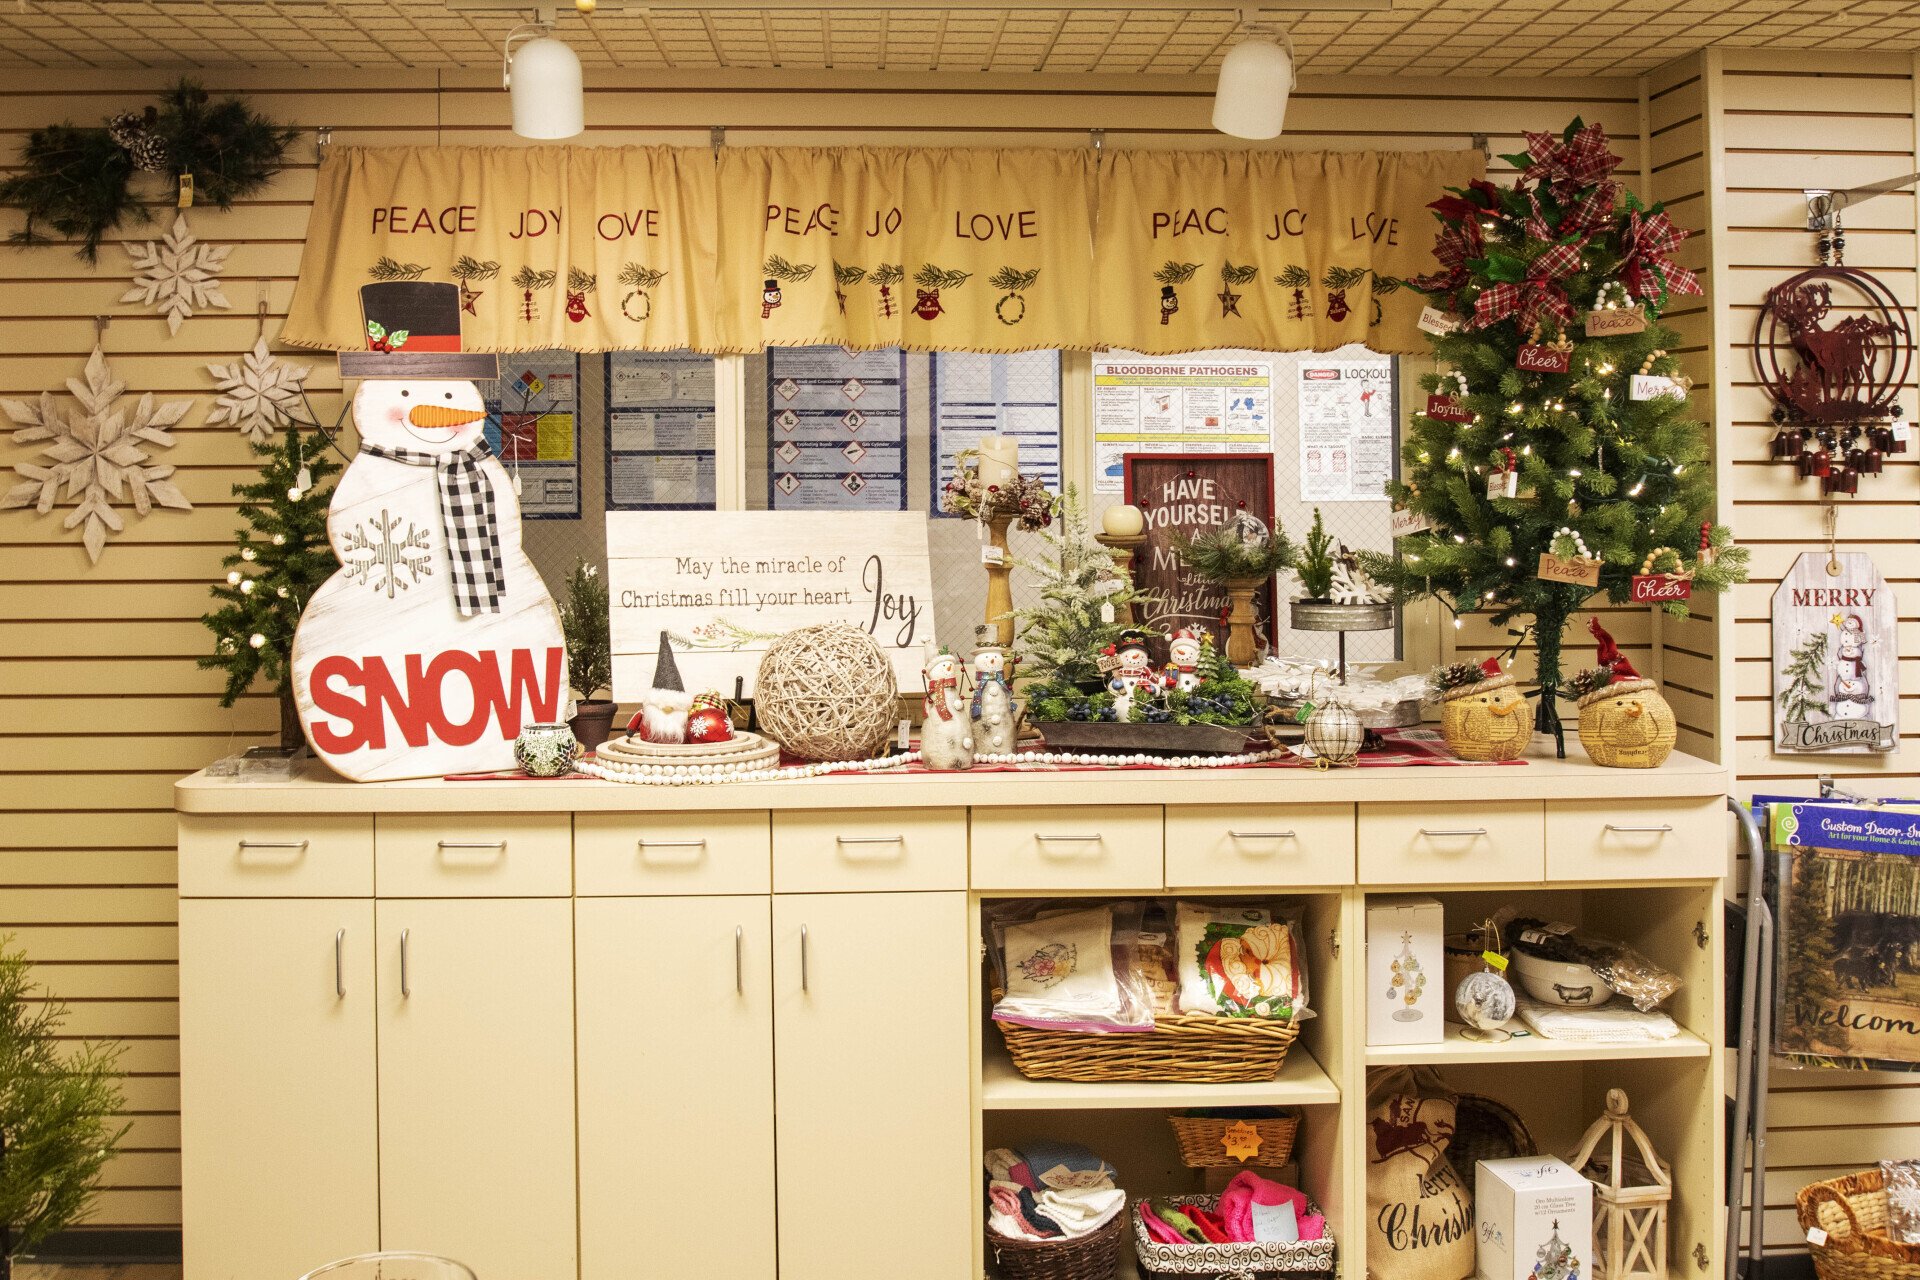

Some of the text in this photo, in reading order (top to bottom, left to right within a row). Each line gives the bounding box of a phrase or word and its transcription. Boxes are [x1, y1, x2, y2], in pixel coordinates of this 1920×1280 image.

[371, 205, 477, 235] PEACE
[597, 209, 659, 241] OVE
[866, 207, 902, 237] JO
[957, 210, 1038, 241] LOVE
[1152, 207, 1229, 239] PEAC
[1266, 208, 1307, 241] JO
[1591, 314, 1637, 331] Peace
[1106, 366, 1258, 376] BLOODBORNE PATHOGENS
[1519, 348, 1561, 369] Cheer
[1431, 402, 1466, 418] Joyfu
[1163, 478, 1216, 503] HAVE
[675, 555, 847, 580] May the miracle of
[1545, 557, 1590, 578] Peace
[621, 587, 852, 612] Christmas fill your heart
[861, 554, 923, 649] Joy
[1143, 584, 1232, 620] Christma
[1636, 580, 1688, 599] Cheer
[1791, 588, 1877, 607] MERRY
[1099, 657, 1120, 669] NOEL
[309, 647, 563, 755] SNOW
[1802, 722, 1880, 746] Christmas
[1821, 817, 1862, 834] Custom
[1828, 831, 1840, 839] Art
[1841, 832, 1851, 840] for
[1852, 834, 1868, 842] your
[1869, 835, 1891, 844] Home
